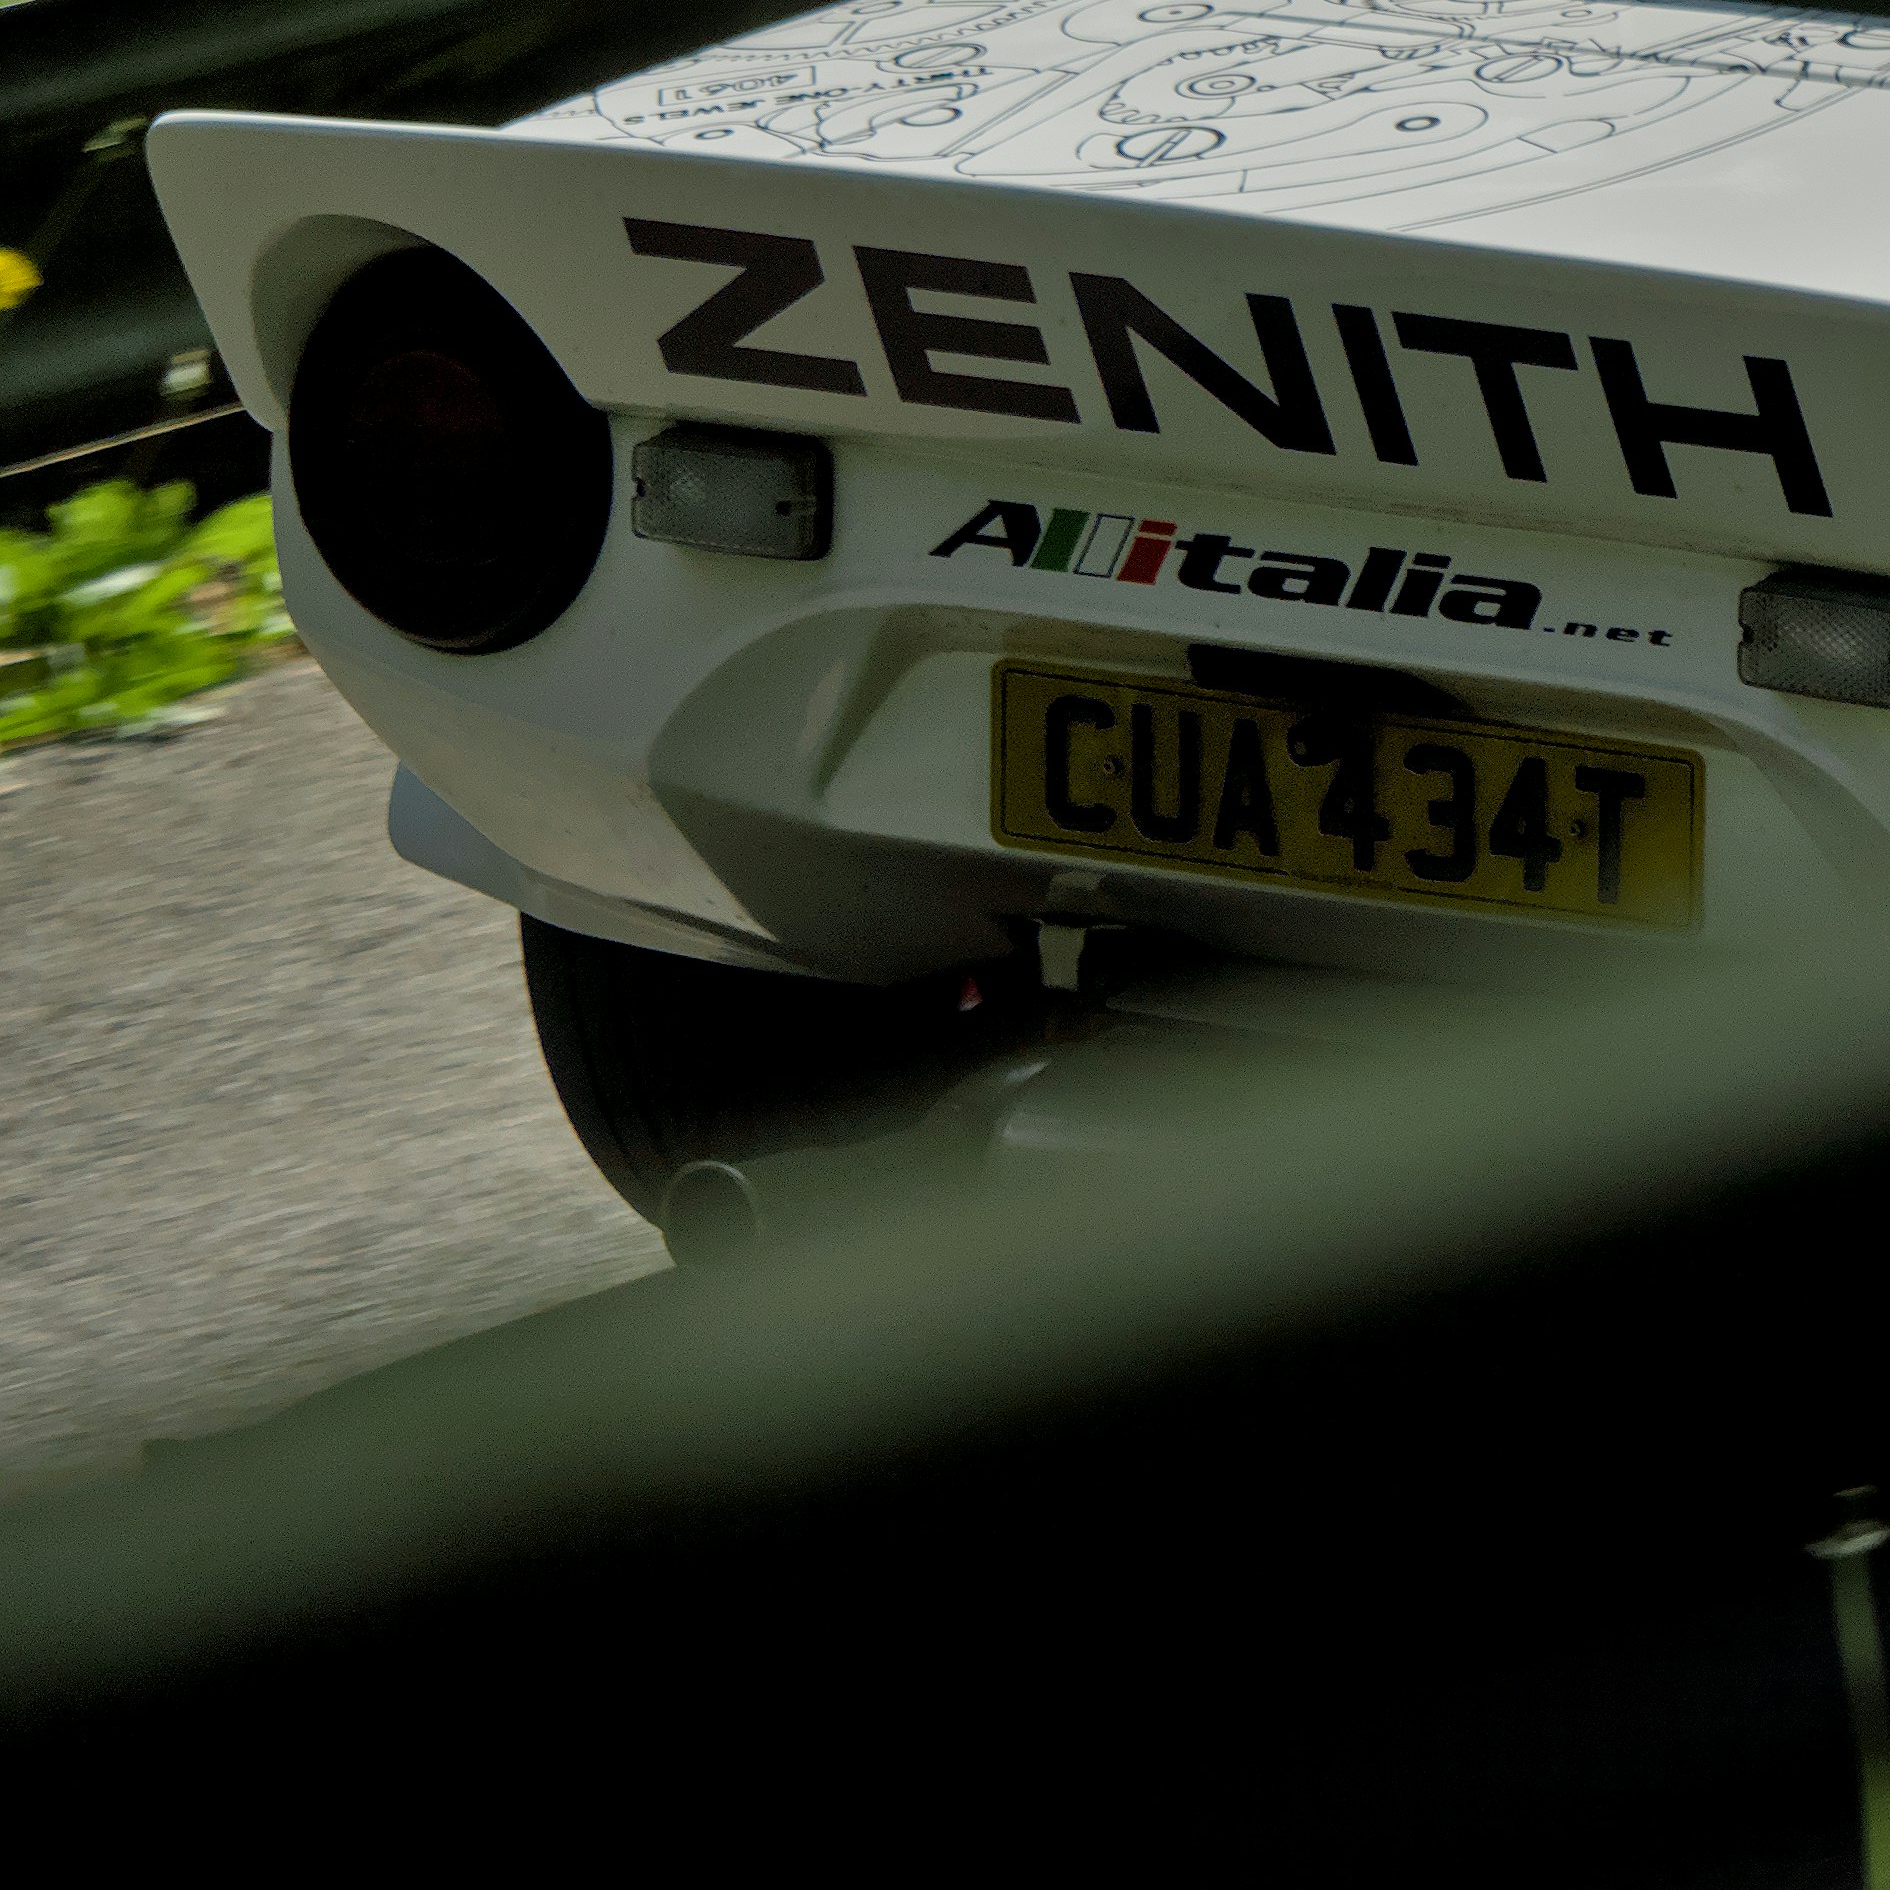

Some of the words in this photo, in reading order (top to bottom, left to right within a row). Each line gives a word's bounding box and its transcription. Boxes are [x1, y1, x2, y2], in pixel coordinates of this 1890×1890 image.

[622, 215, 1834, 518] ZENITH
[1044, 694, 1280, 857] CUA
[1317, 734, 1646, 904] 434T
